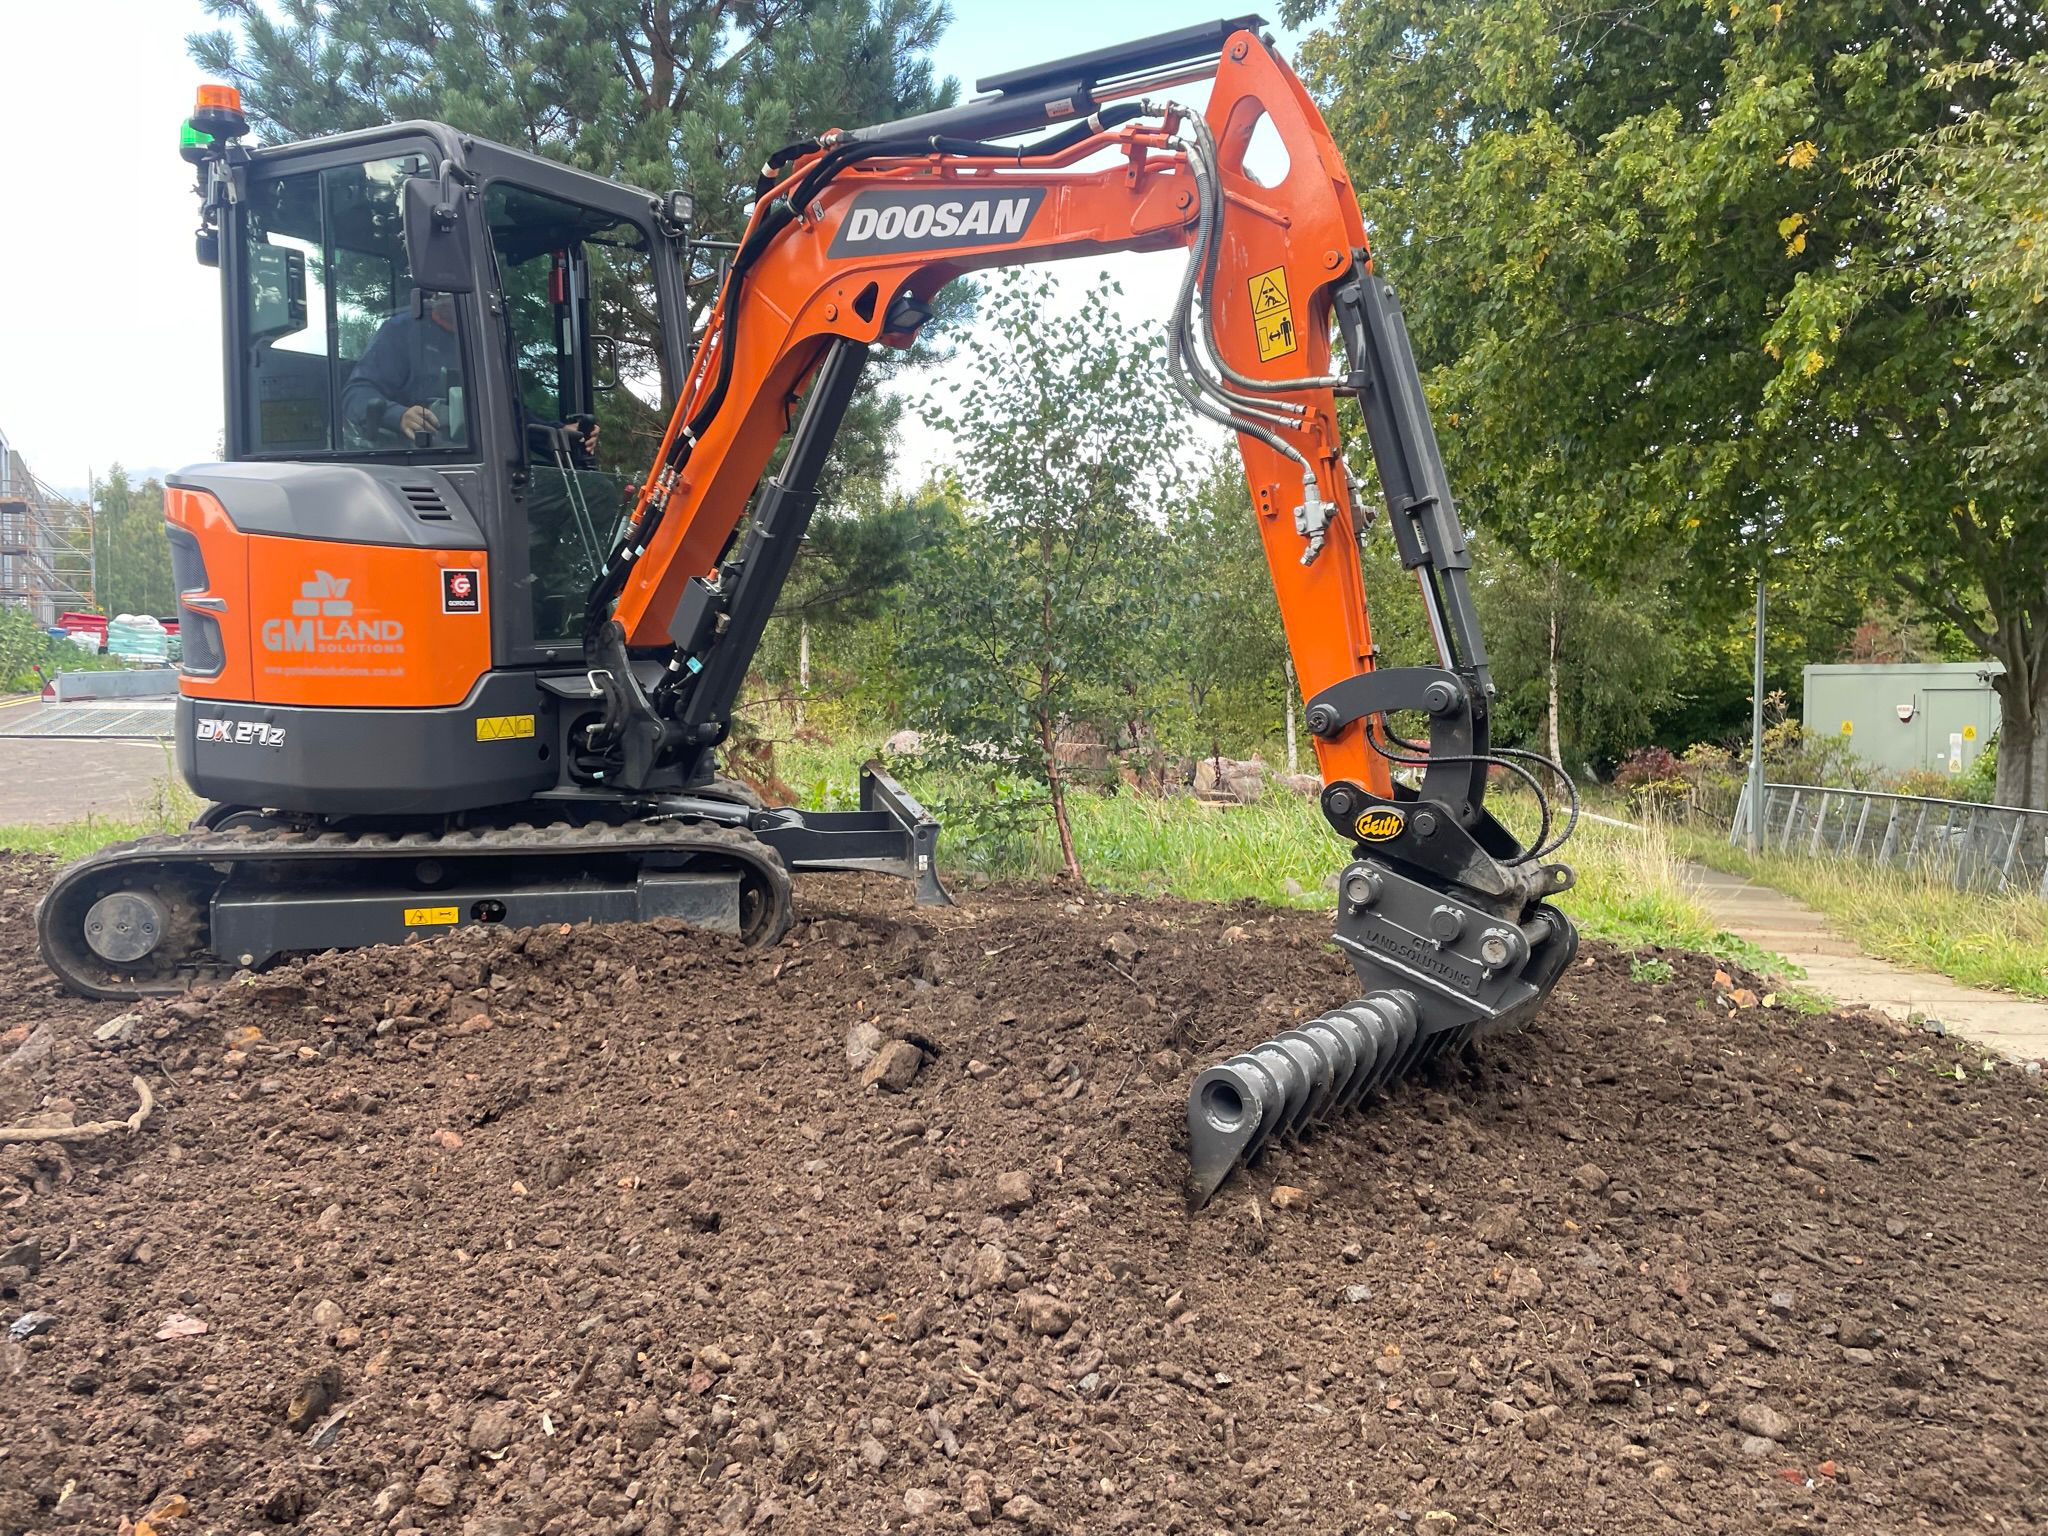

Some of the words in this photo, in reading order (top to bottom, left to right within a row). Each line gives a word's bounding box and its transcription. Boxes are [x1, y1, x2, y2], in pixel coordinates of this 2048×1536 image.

[846, 198, 1030, 241] DOOSAN
[262, 618, 315, 652] GM
[317, 620, 404, 641] LAND
[318, 643, 405, 653] SOLUTIONS
[1366, 930, 1397, 952] LAND
[1398, 944, 1471, 987] SOLUTIONS
